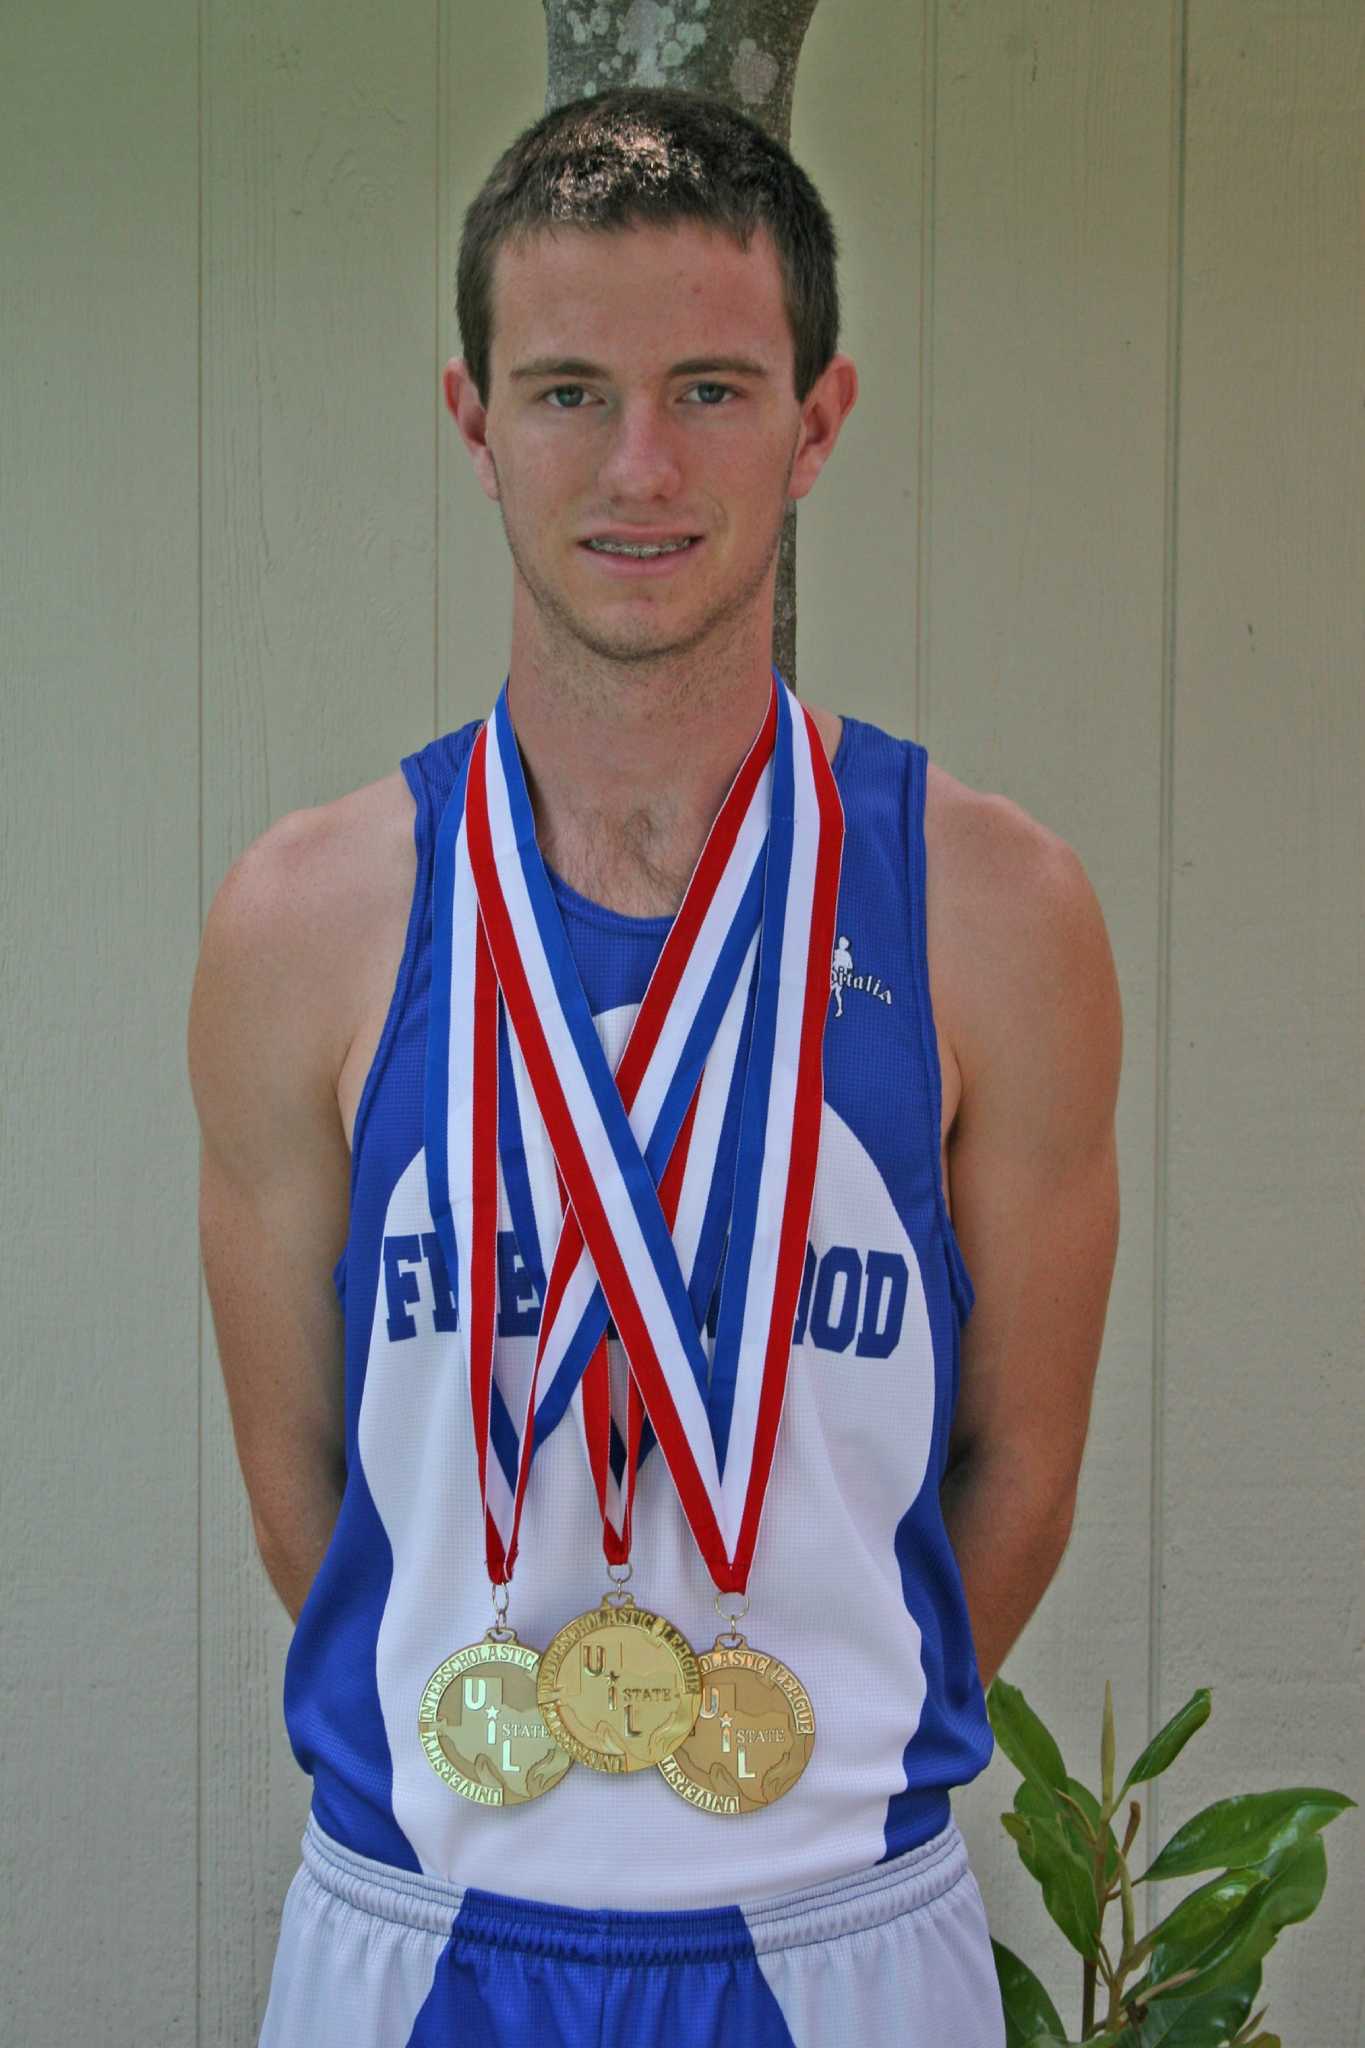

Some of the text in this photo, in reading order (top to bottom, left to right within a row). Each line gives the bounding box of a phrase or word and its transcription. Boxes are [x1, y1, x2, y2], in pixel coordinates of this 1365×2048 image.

[660, 1622, 701, 1694] LEAGUE
[623, 1688, 671, 1702] STATE
[419, 1643, 540, 1806] UNIVERSITY INTERSCHOLASTIC
[502, 1723, 550, 1738] STATE
[658, 1754, 740, 1814] UNIVERSIT
[771, 1664, 815, 1734] LEAGUE
[736, 1729, 785, 1744] STATE
